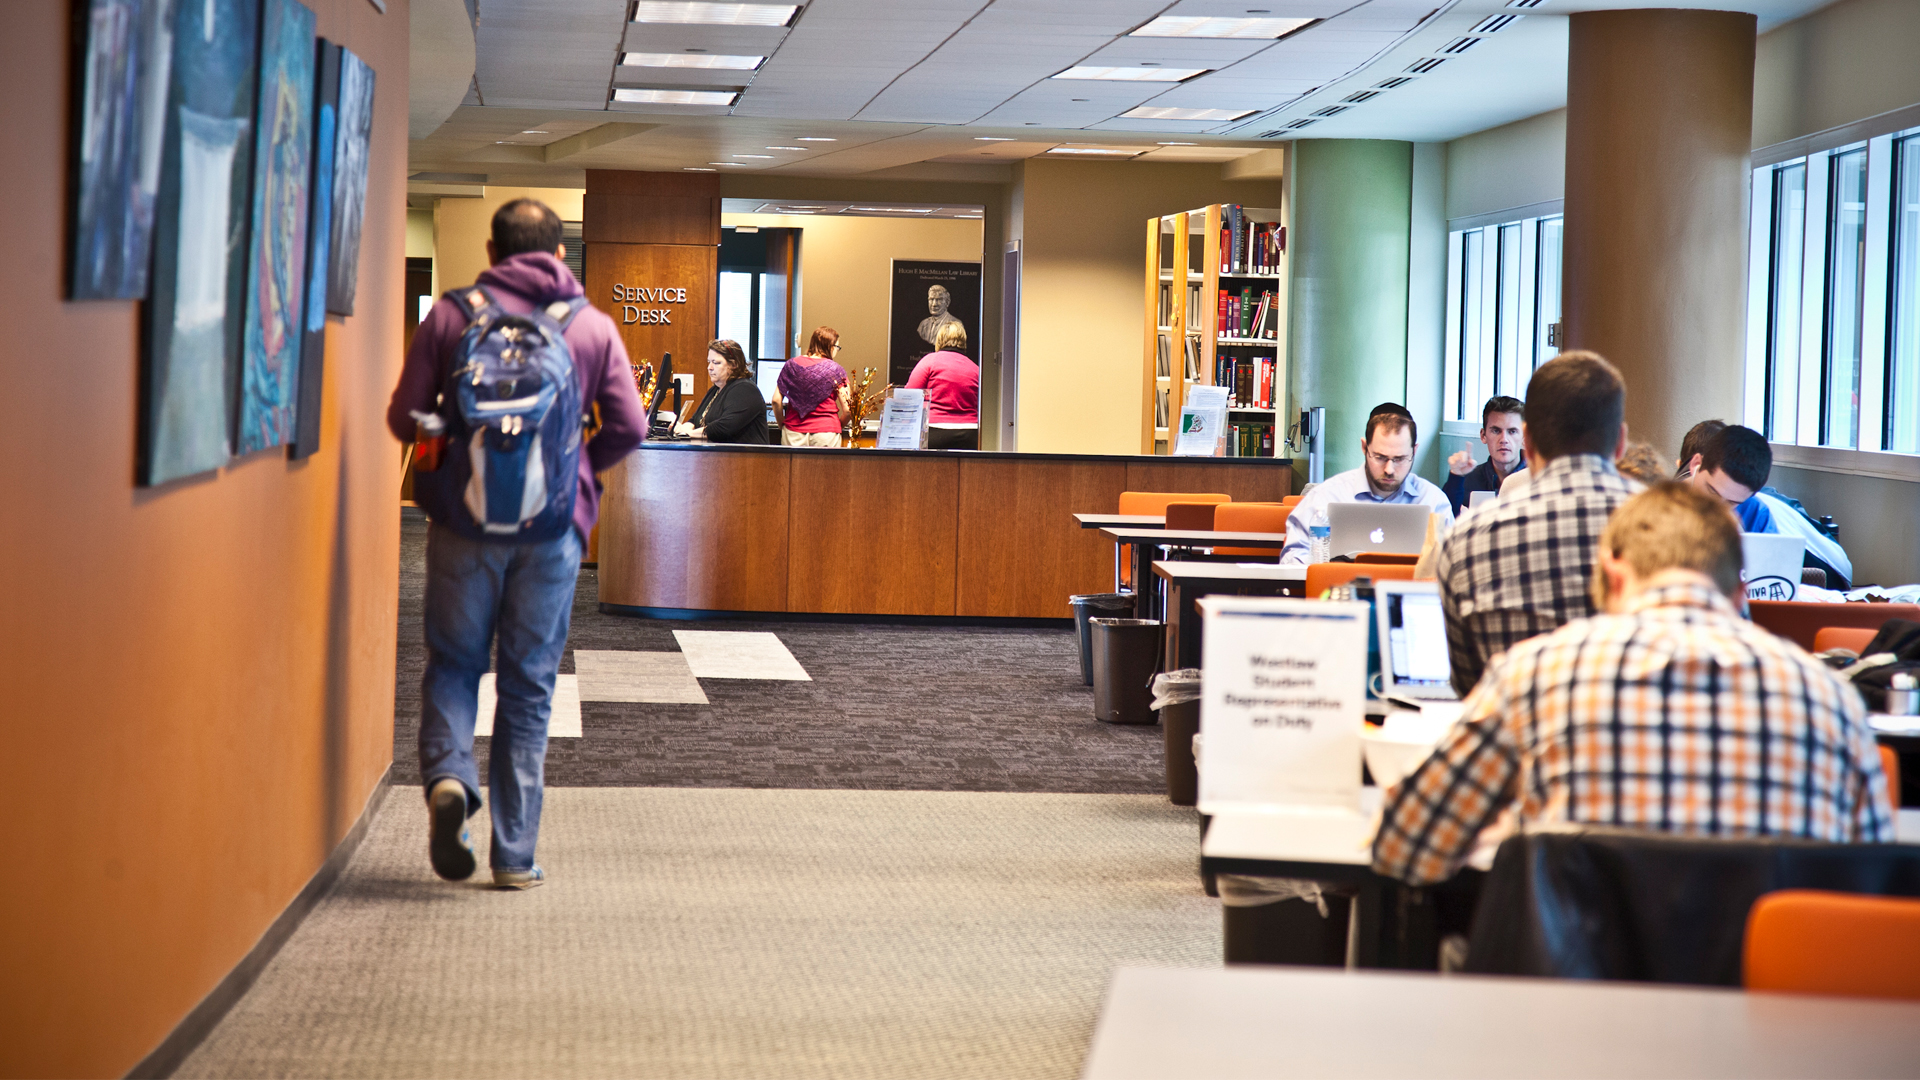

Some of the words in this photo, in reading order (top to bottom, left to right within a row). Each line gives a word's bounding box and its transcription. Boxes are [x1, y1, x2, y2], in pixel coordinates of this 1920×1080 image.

[613, 283, 687, 303] SERVICE
[623, 305, 672, 324] DESK
[1745, 587, 1766, 599] VIVA
[1253, 676, 1315, 689] Student
[1224, 693, 1342, 710] Representative
[1253, 717, 1270, 728] on
[1276, 716, 1313, 731] Duty
